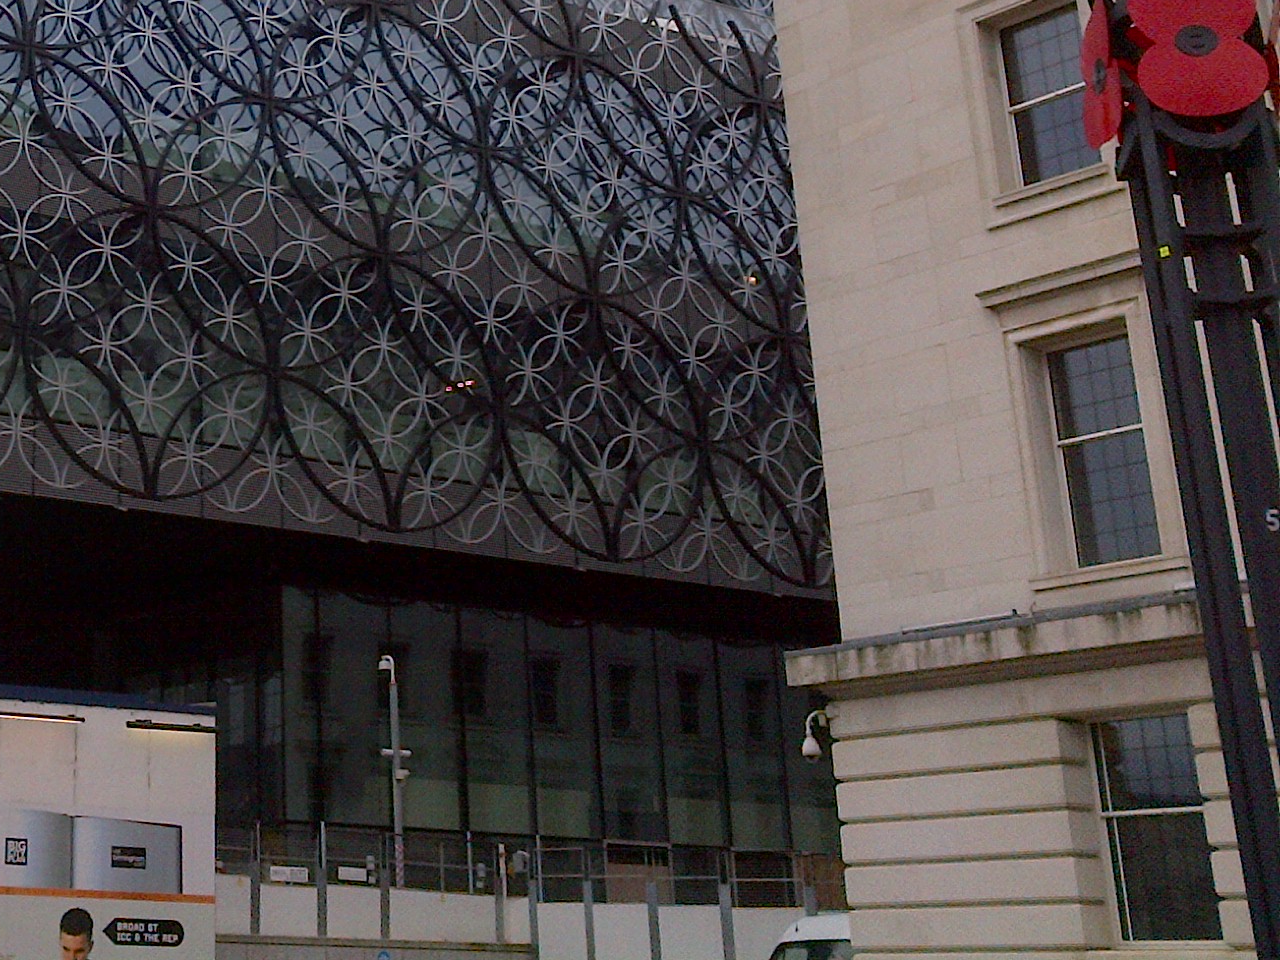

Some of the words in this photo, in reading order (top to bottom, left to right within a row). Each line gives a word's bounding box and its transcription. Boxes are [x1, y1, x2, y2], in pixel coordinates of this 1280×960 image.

[116, 922, 145, 932] BROAD
[148, 923, 159, 932] ST
[117, 932, 132, 942] ICC
[143, 933, 160, 943] THE
